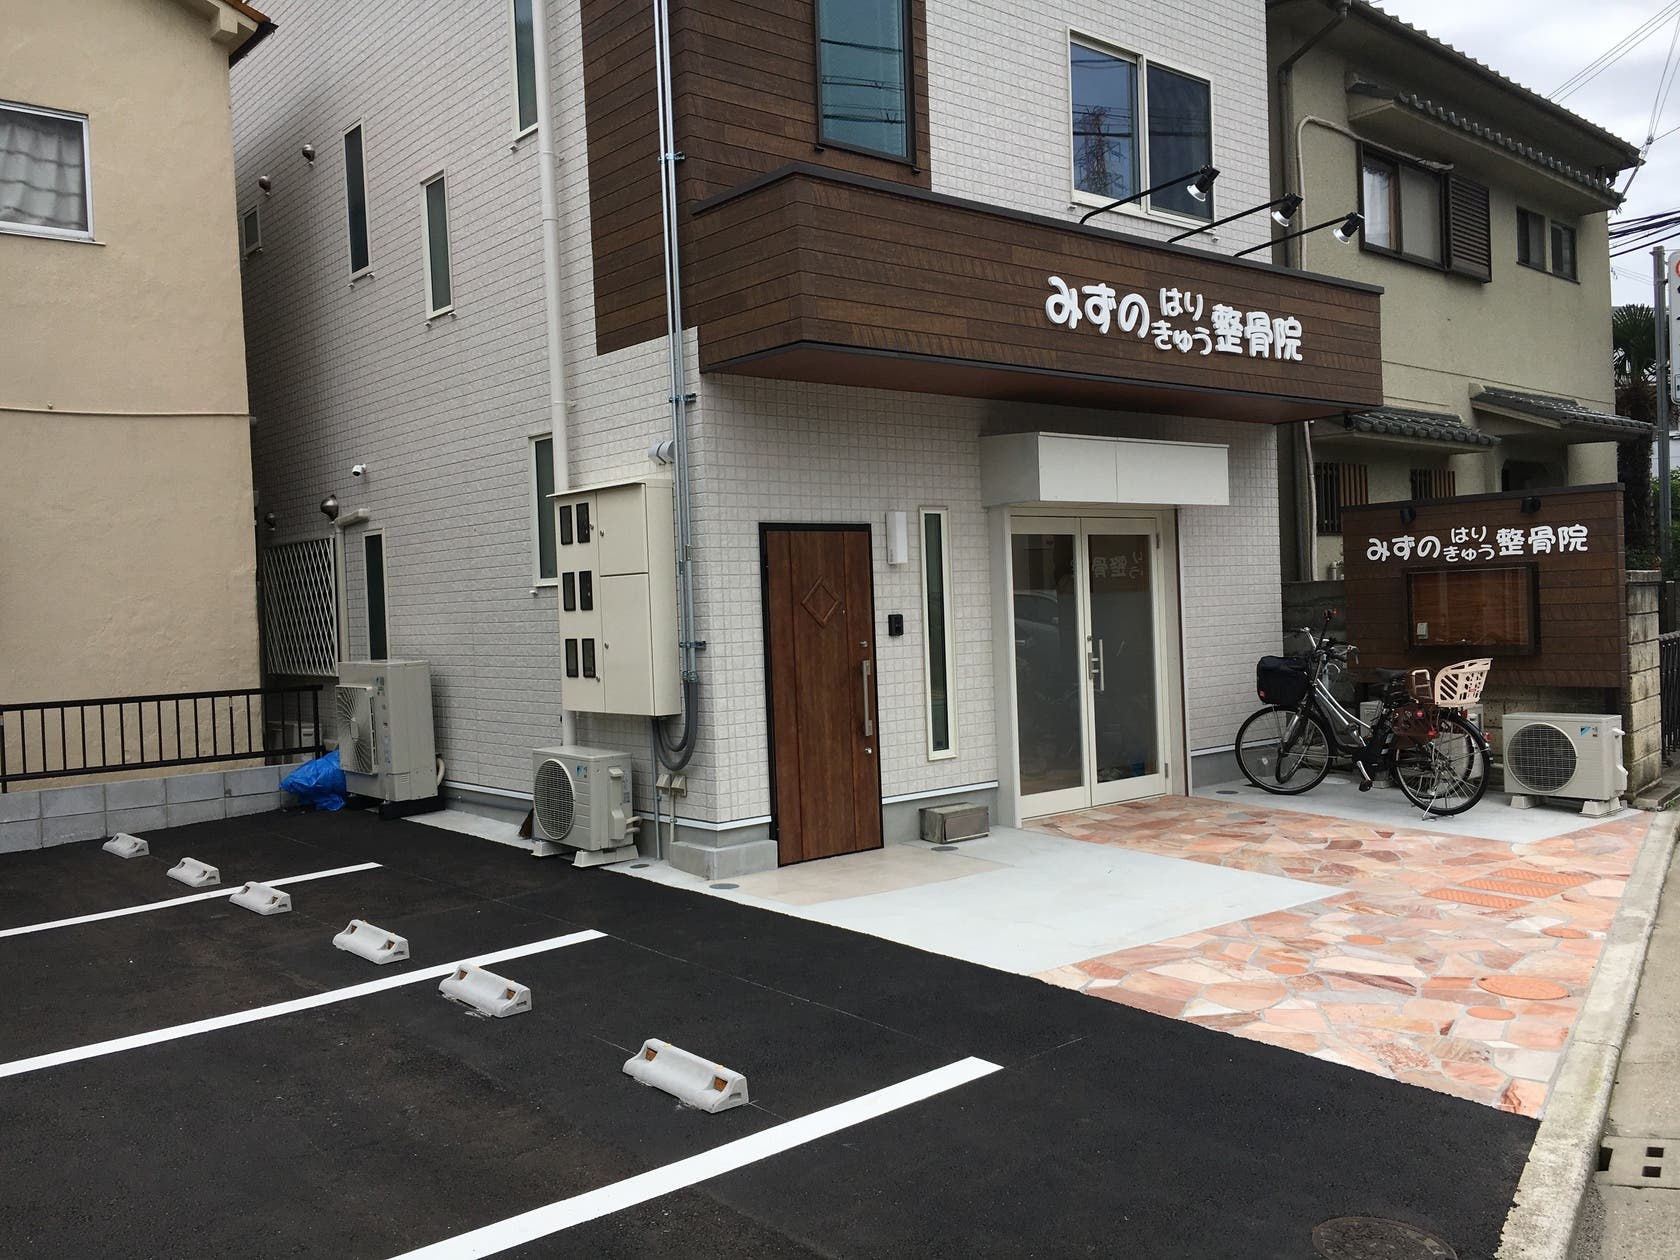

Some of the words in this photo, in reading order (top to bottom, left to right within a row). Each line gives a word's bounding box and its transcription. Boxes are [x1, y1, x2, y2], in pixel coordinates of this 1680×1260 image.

[1045, 275, 1151, 339] みずの
[1159, 287, 1204, 322] はり
[1150, 319, 1213, 356] きゅう
[1210, 302, 1304, 361] 整骨院
[1366, 534, 1441, 562] みずの
[1450, 525, 1487, 544] はり
[1495, 523, 1589, 556] 整骨院
[1443, 543, 1496, 563] きゅう
